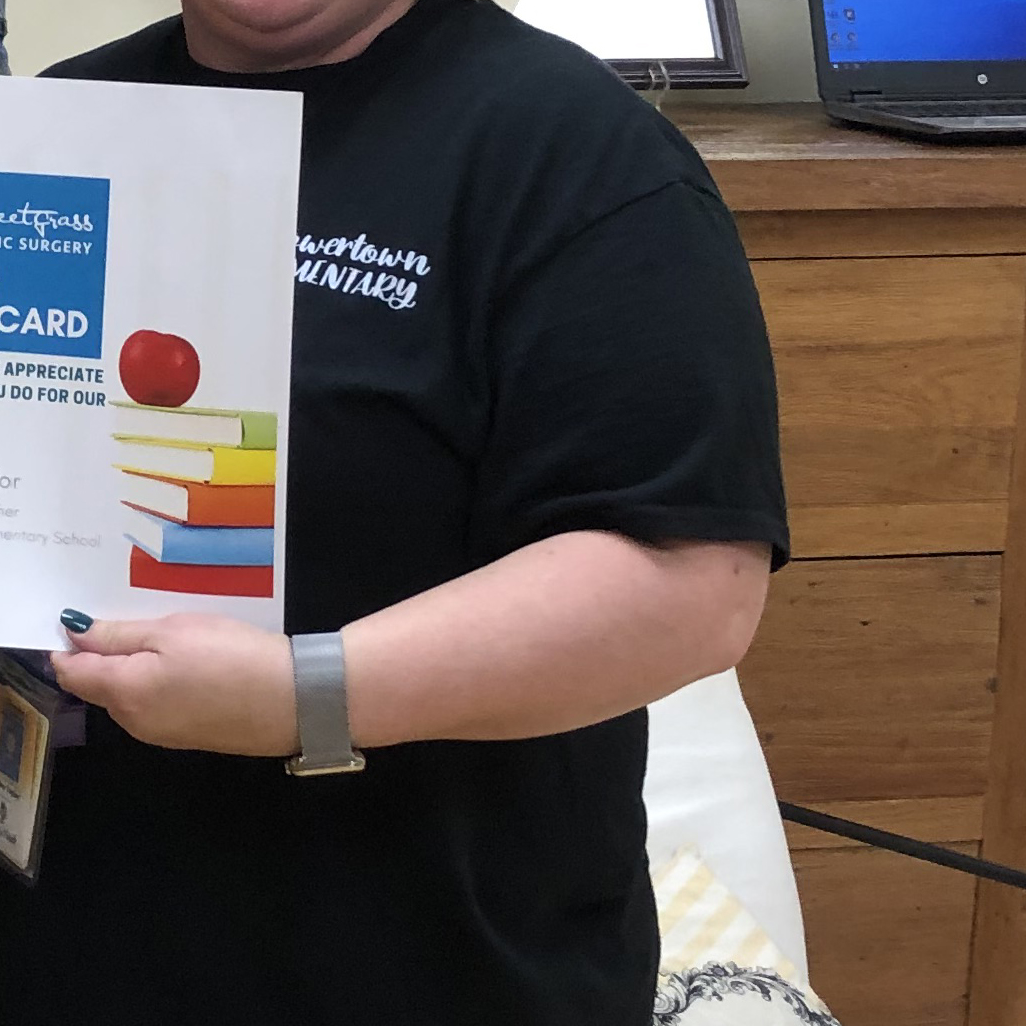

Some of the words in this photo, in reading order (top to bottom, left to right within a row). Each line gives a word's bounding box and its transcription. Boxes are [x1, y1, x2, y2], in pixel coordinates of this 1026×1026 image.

[18, 238, 93, 255] SURGERY
[296, 233, 431, 276] wertown
[4, 362, 104, 383] APPRECIATE
[10, 385, 33, 400] DO
[38, 387, 68, 404] FOR
[74, 390, 106, 407] OUR
[52, 530, 103, 548] School
